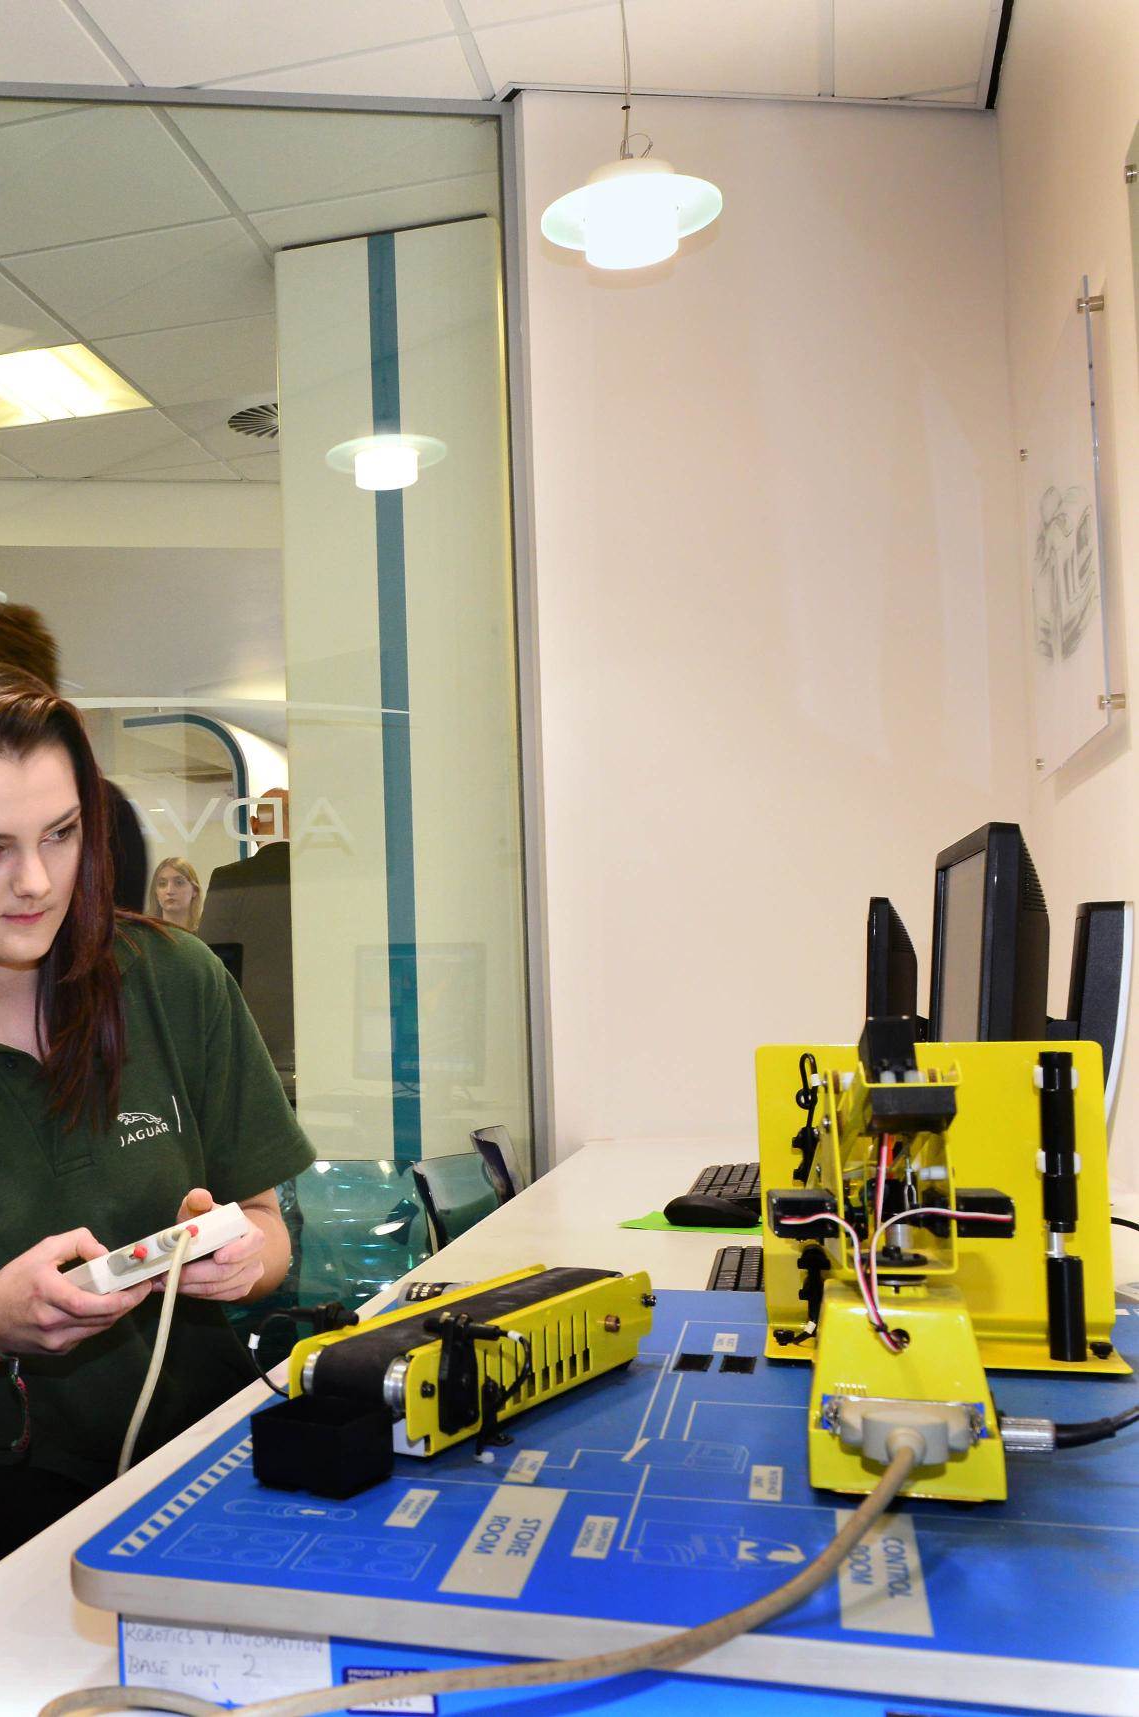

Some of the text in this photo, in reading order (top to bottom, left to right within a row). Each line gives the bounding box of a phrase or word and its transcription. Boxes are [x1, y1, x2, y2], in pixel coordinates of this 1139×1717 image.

[120, 1122, 170, 1148] JAGUAR
[472, 1515, 512, 1555] ROOM
[505, 1517, 542, 1558] STORE
[882, 1536, 913, 1599] CONTROL
[126, 1654, 169, 1676] BASE
[242, 1653, 263, 1679] 2
